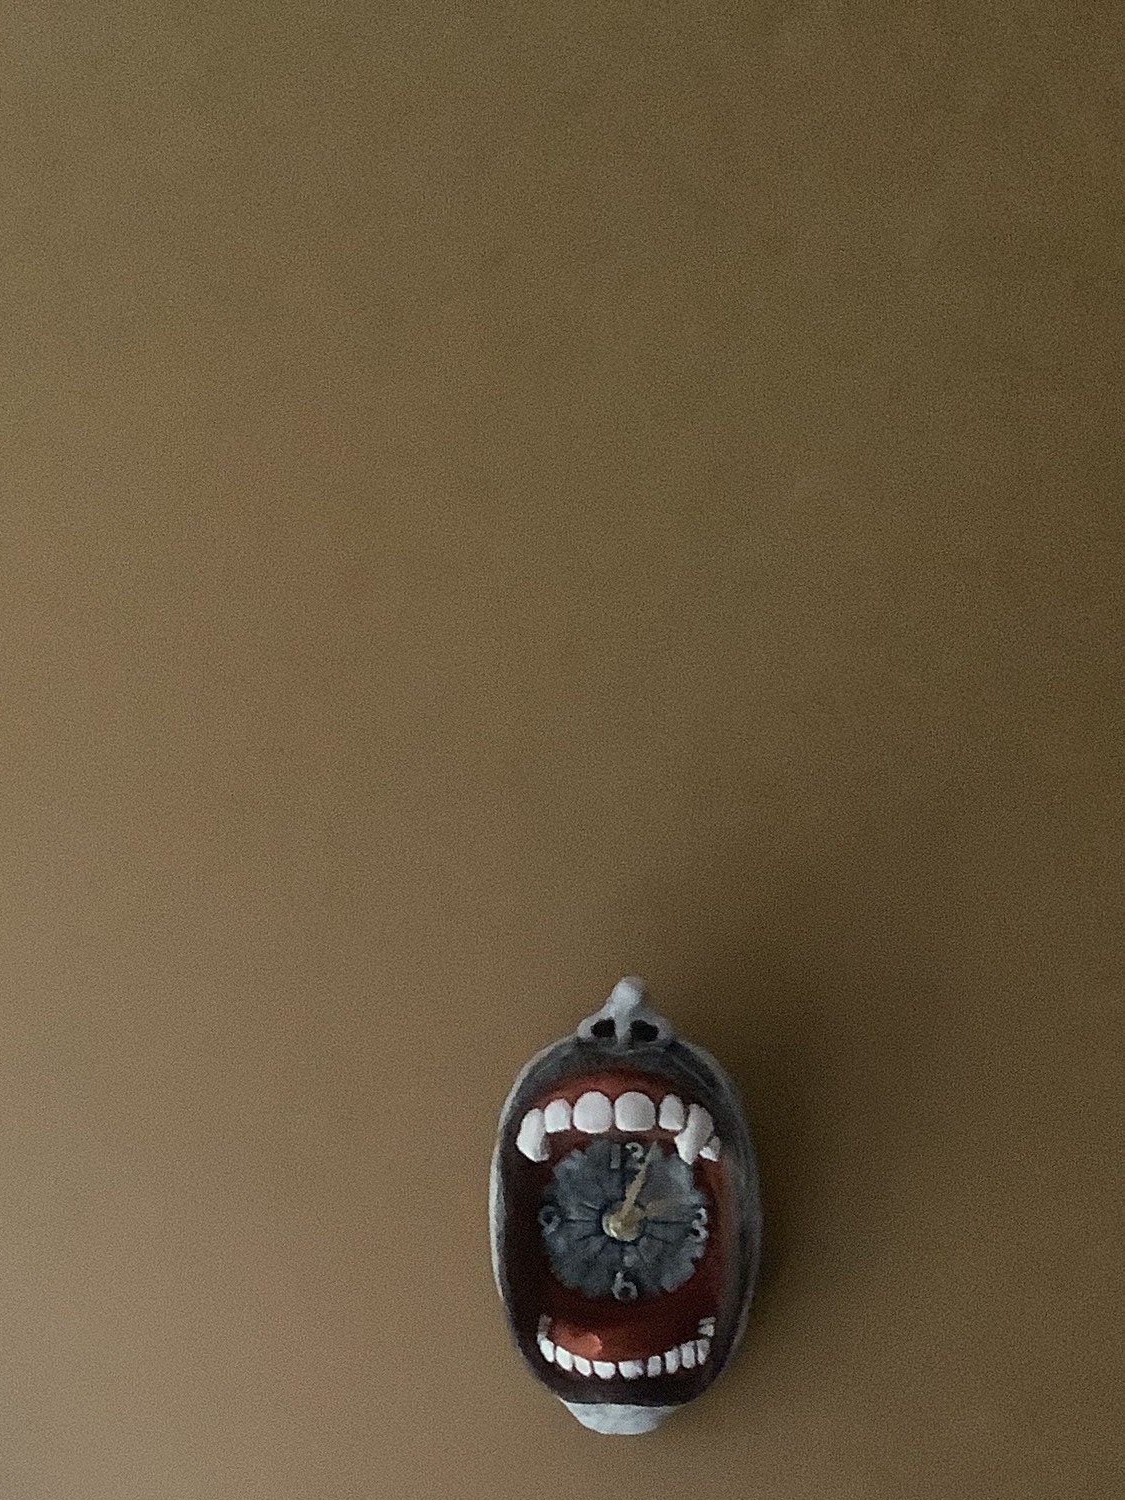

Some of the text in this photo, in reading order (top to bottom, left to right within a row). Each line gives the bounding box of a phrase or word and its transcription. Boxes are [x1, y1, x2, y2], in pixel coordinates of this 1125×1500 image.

[610, 1142, 646, 1170] 12
[539, 1205, 562, 1236] 9
[689, 1207, 709, 1243] 3
[612, 1271, 638, 1302] 6
